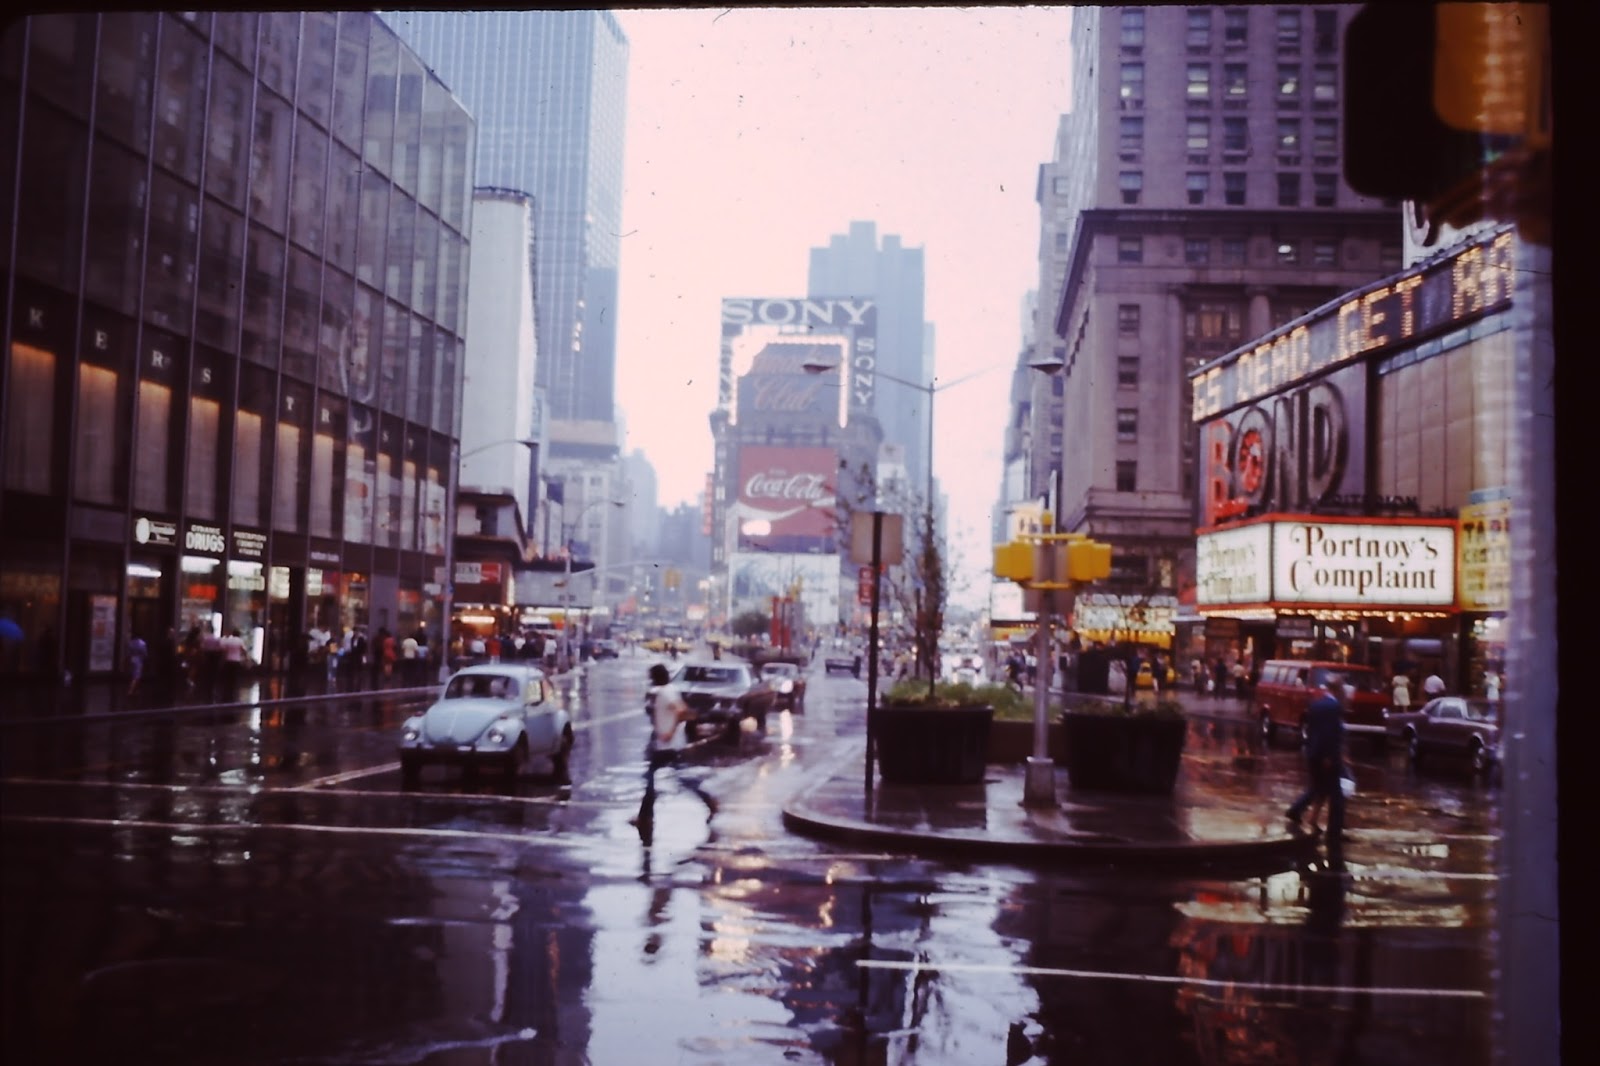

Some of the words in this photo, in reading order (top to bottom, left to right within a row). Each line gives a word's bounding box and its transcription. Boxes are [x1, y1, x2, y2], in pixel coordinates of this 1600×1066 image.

[721, 299, 875, 326] SONY
[1338, 275, 1423, 358] GET
[855, 337, 874, 405] SONY
[1206, 381, 1348, 524] BOND
[185, 531, 225, 553] DRUGS
[1291, 524, 1438, 560] Portnoy's
[1290, 560, 1437, 595] Complaint
